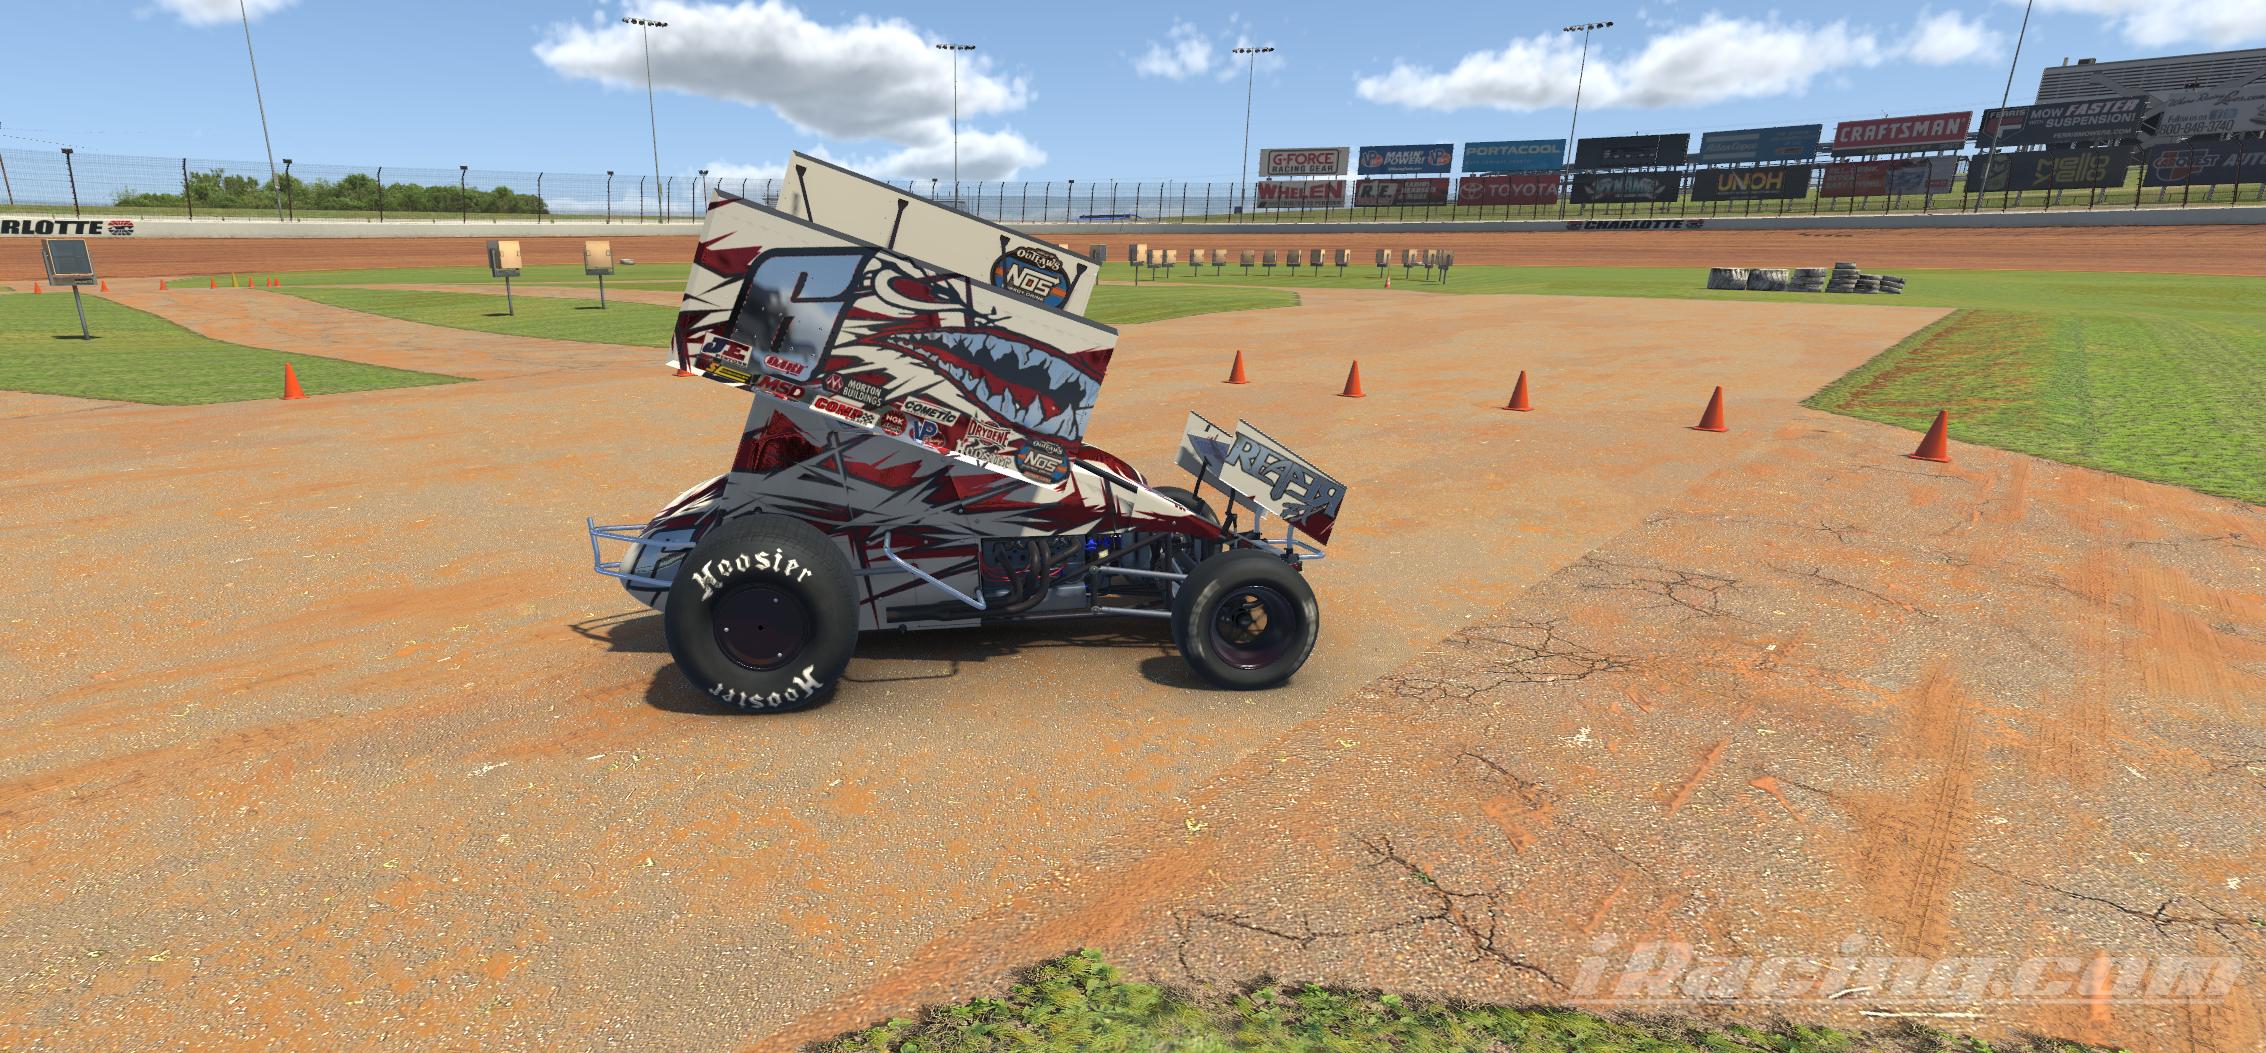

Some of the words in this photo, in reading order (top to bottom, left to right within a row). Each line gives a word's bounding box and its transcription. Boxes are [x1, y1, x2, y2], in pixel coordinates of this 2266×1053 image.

[2030, 107, 2064, 119] MOW
[2065, 99, 2140, 116] FASTER
[1840, 118, 1960, 143] CRAFTSMAN
[2045, 112, 2136, 128] SUSPENSION!
[1273, 152, 1335, 165] G-FORCE
[1466, 144, 1560, 156] PORTACOOL
[1258, 180, 1343, 200] WHELEN
[1488, 182, 1558, 197] TOYOTA
[1718, 170, 1784, 191] UNOH
[1584, 219, 1684, 230] CHARLOTTE
[1006, 263, 1061, 298] NOS
[702, 336, 750, 362] JE
[757, 375, 806, 400] MSD
[843, 386, 882, 407] BUILDINGS
[848, 379, 882, 399] MORTON
[814, 397, 864, 418] COMP
[886, 414, 904, 426] NGK
[968, 420, 1011, 447] DRYDENE
[1024, 450, 1062, 473] NOS
[692, 548, 813, 602] Hoosier
[708, 664, 825, 709] Hoosier
